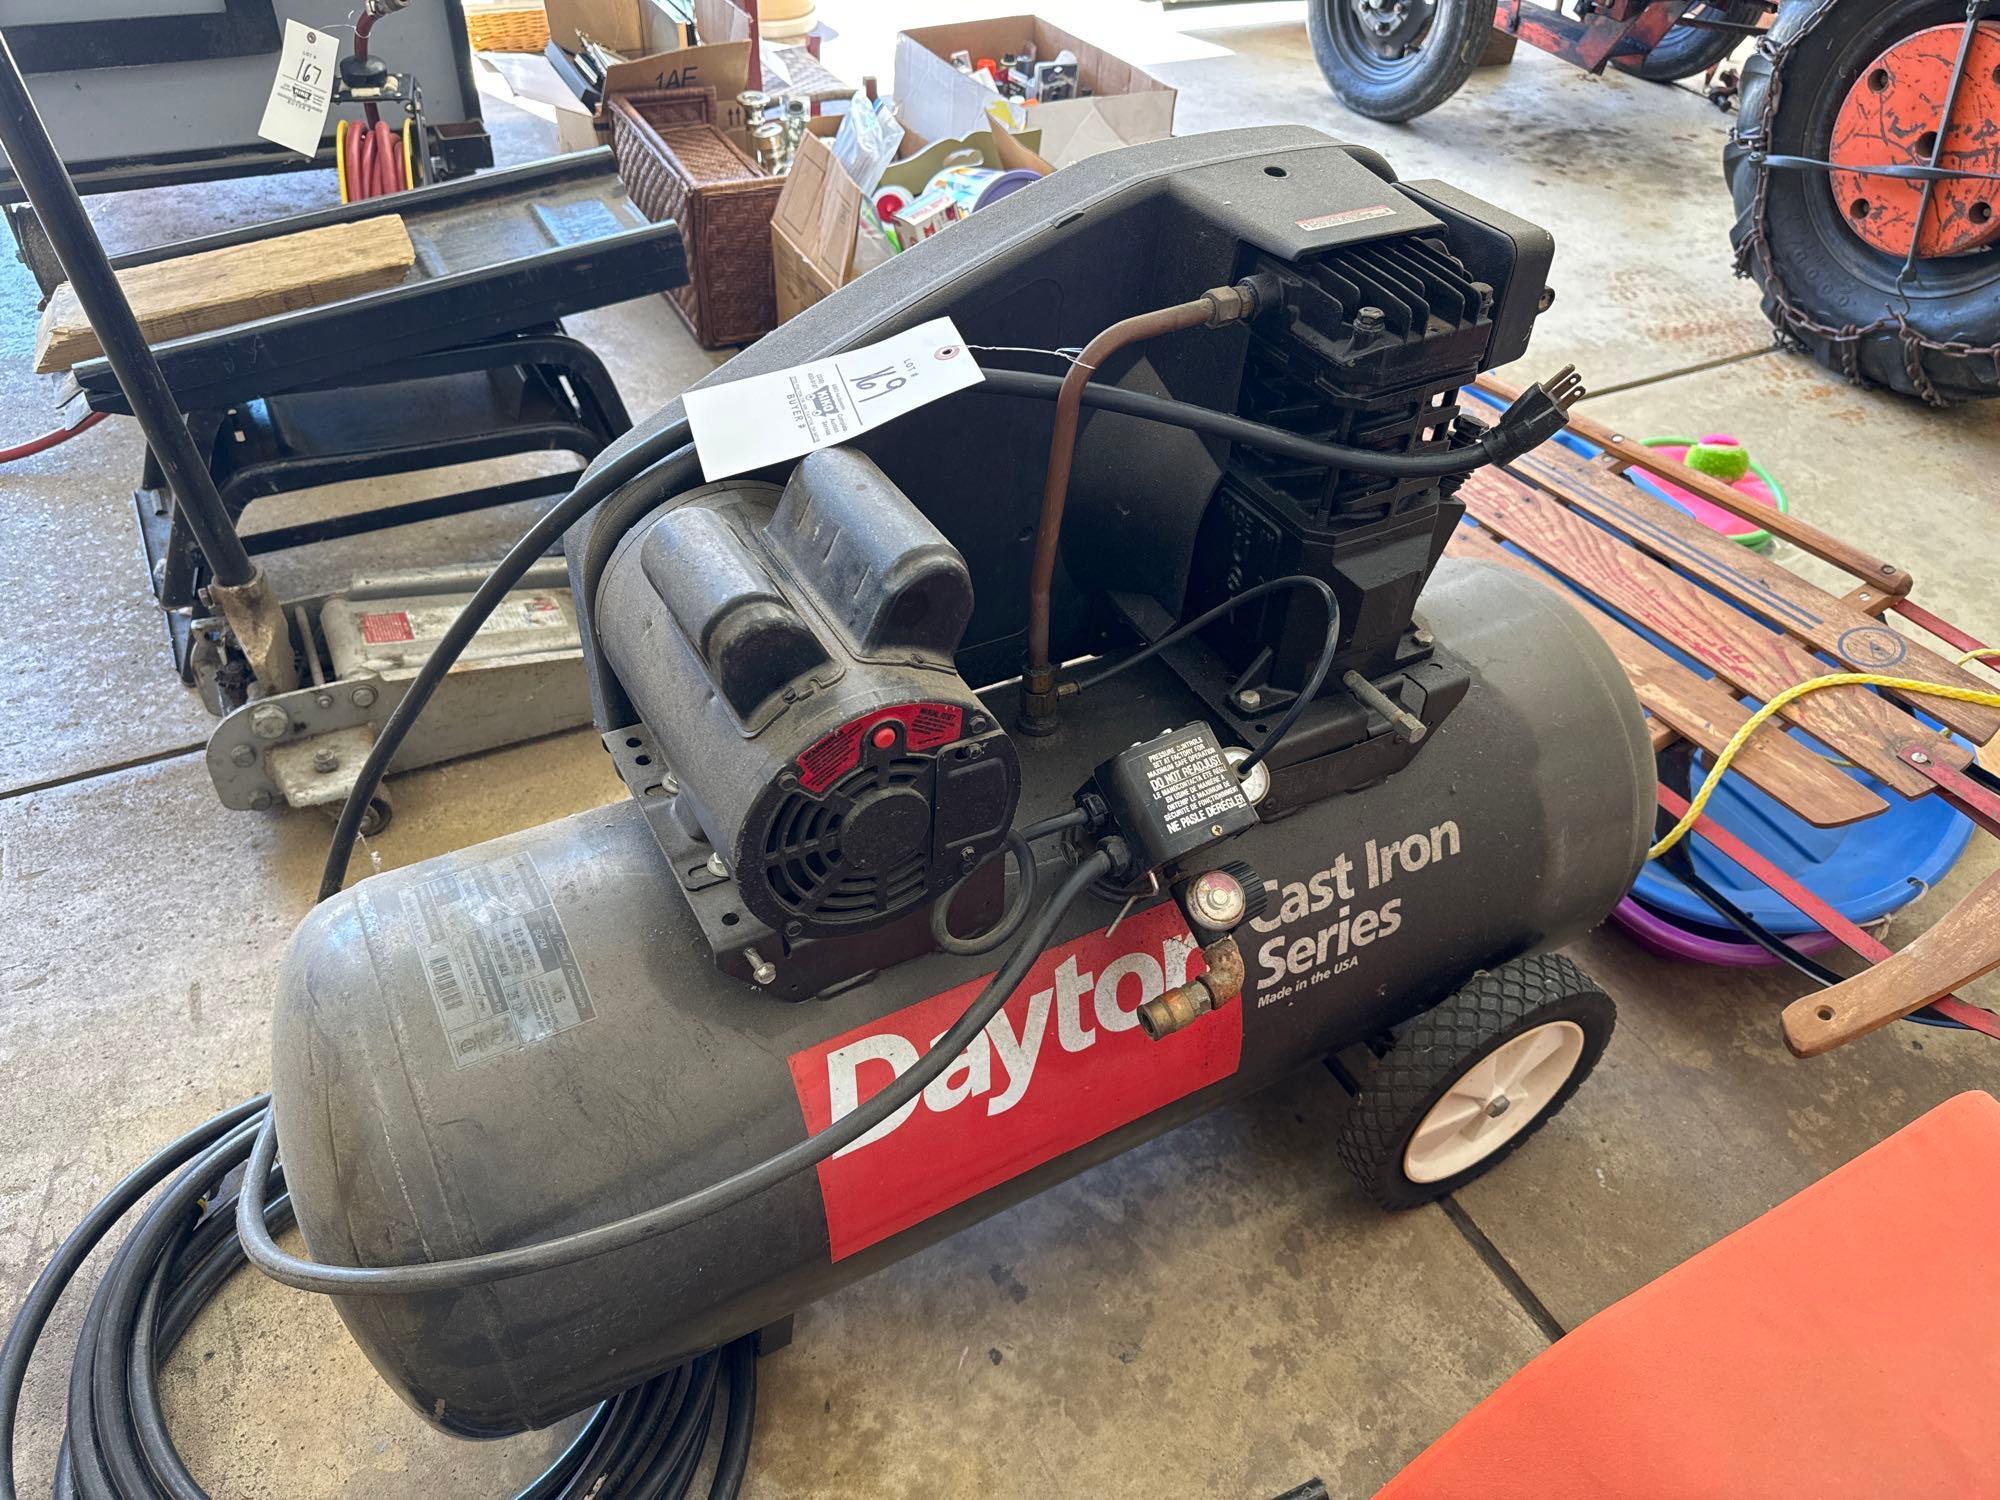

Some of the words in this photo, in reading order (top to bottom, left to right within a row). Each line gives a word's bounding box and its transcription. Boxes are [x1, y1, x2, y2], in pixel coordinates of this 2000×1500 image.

[296, 58, 322, 85] 167
[903, 357, 915, 371] LOT
[850, 366, 906, 403] 169
[786, 393, 803, 421] BUYER
[817, 389, 833, 411] KIKO
[1147, 762, 1174, 778] MAXIMUM
[1174, 757, 1187, 767] SAFE
[1188, 746, 1215, 762] OPERATION
[1148, 746, 1174, 762] PRESSURE
[1152, 760, 1162, 768] SET
[1163, 756, 1170, 764] AT
[1170, 747, 1193, 761] FACTORY
[1193, 743, 1204, 752] FOR
[1150, 776, 1164, 790] DO
[1164, 769, 1182, 784] NOT
[1182, 753, 1221, 777] READJUST
[1153, 791, 1161, 800] LE
[1165, 795, 1173, 803] EN
[1189, 785, 1197, 793] DE
[1196, 783, 1223, 799] MAXIMUM
[1189, 802, 1197, 810] DE
[1166, 820, 1181, 833] NE
[1249, 853, 1354, 932] Cast
[1365, 820, 1460, 889] Iron
[1257, 898, 1401, 990] Series
[1257, 984, 1292, 1008] Made
[1296, 976, 1307, 991] in
[1311, 969, 1330, 985] the
[1334, 956, 1359, 975] USA
